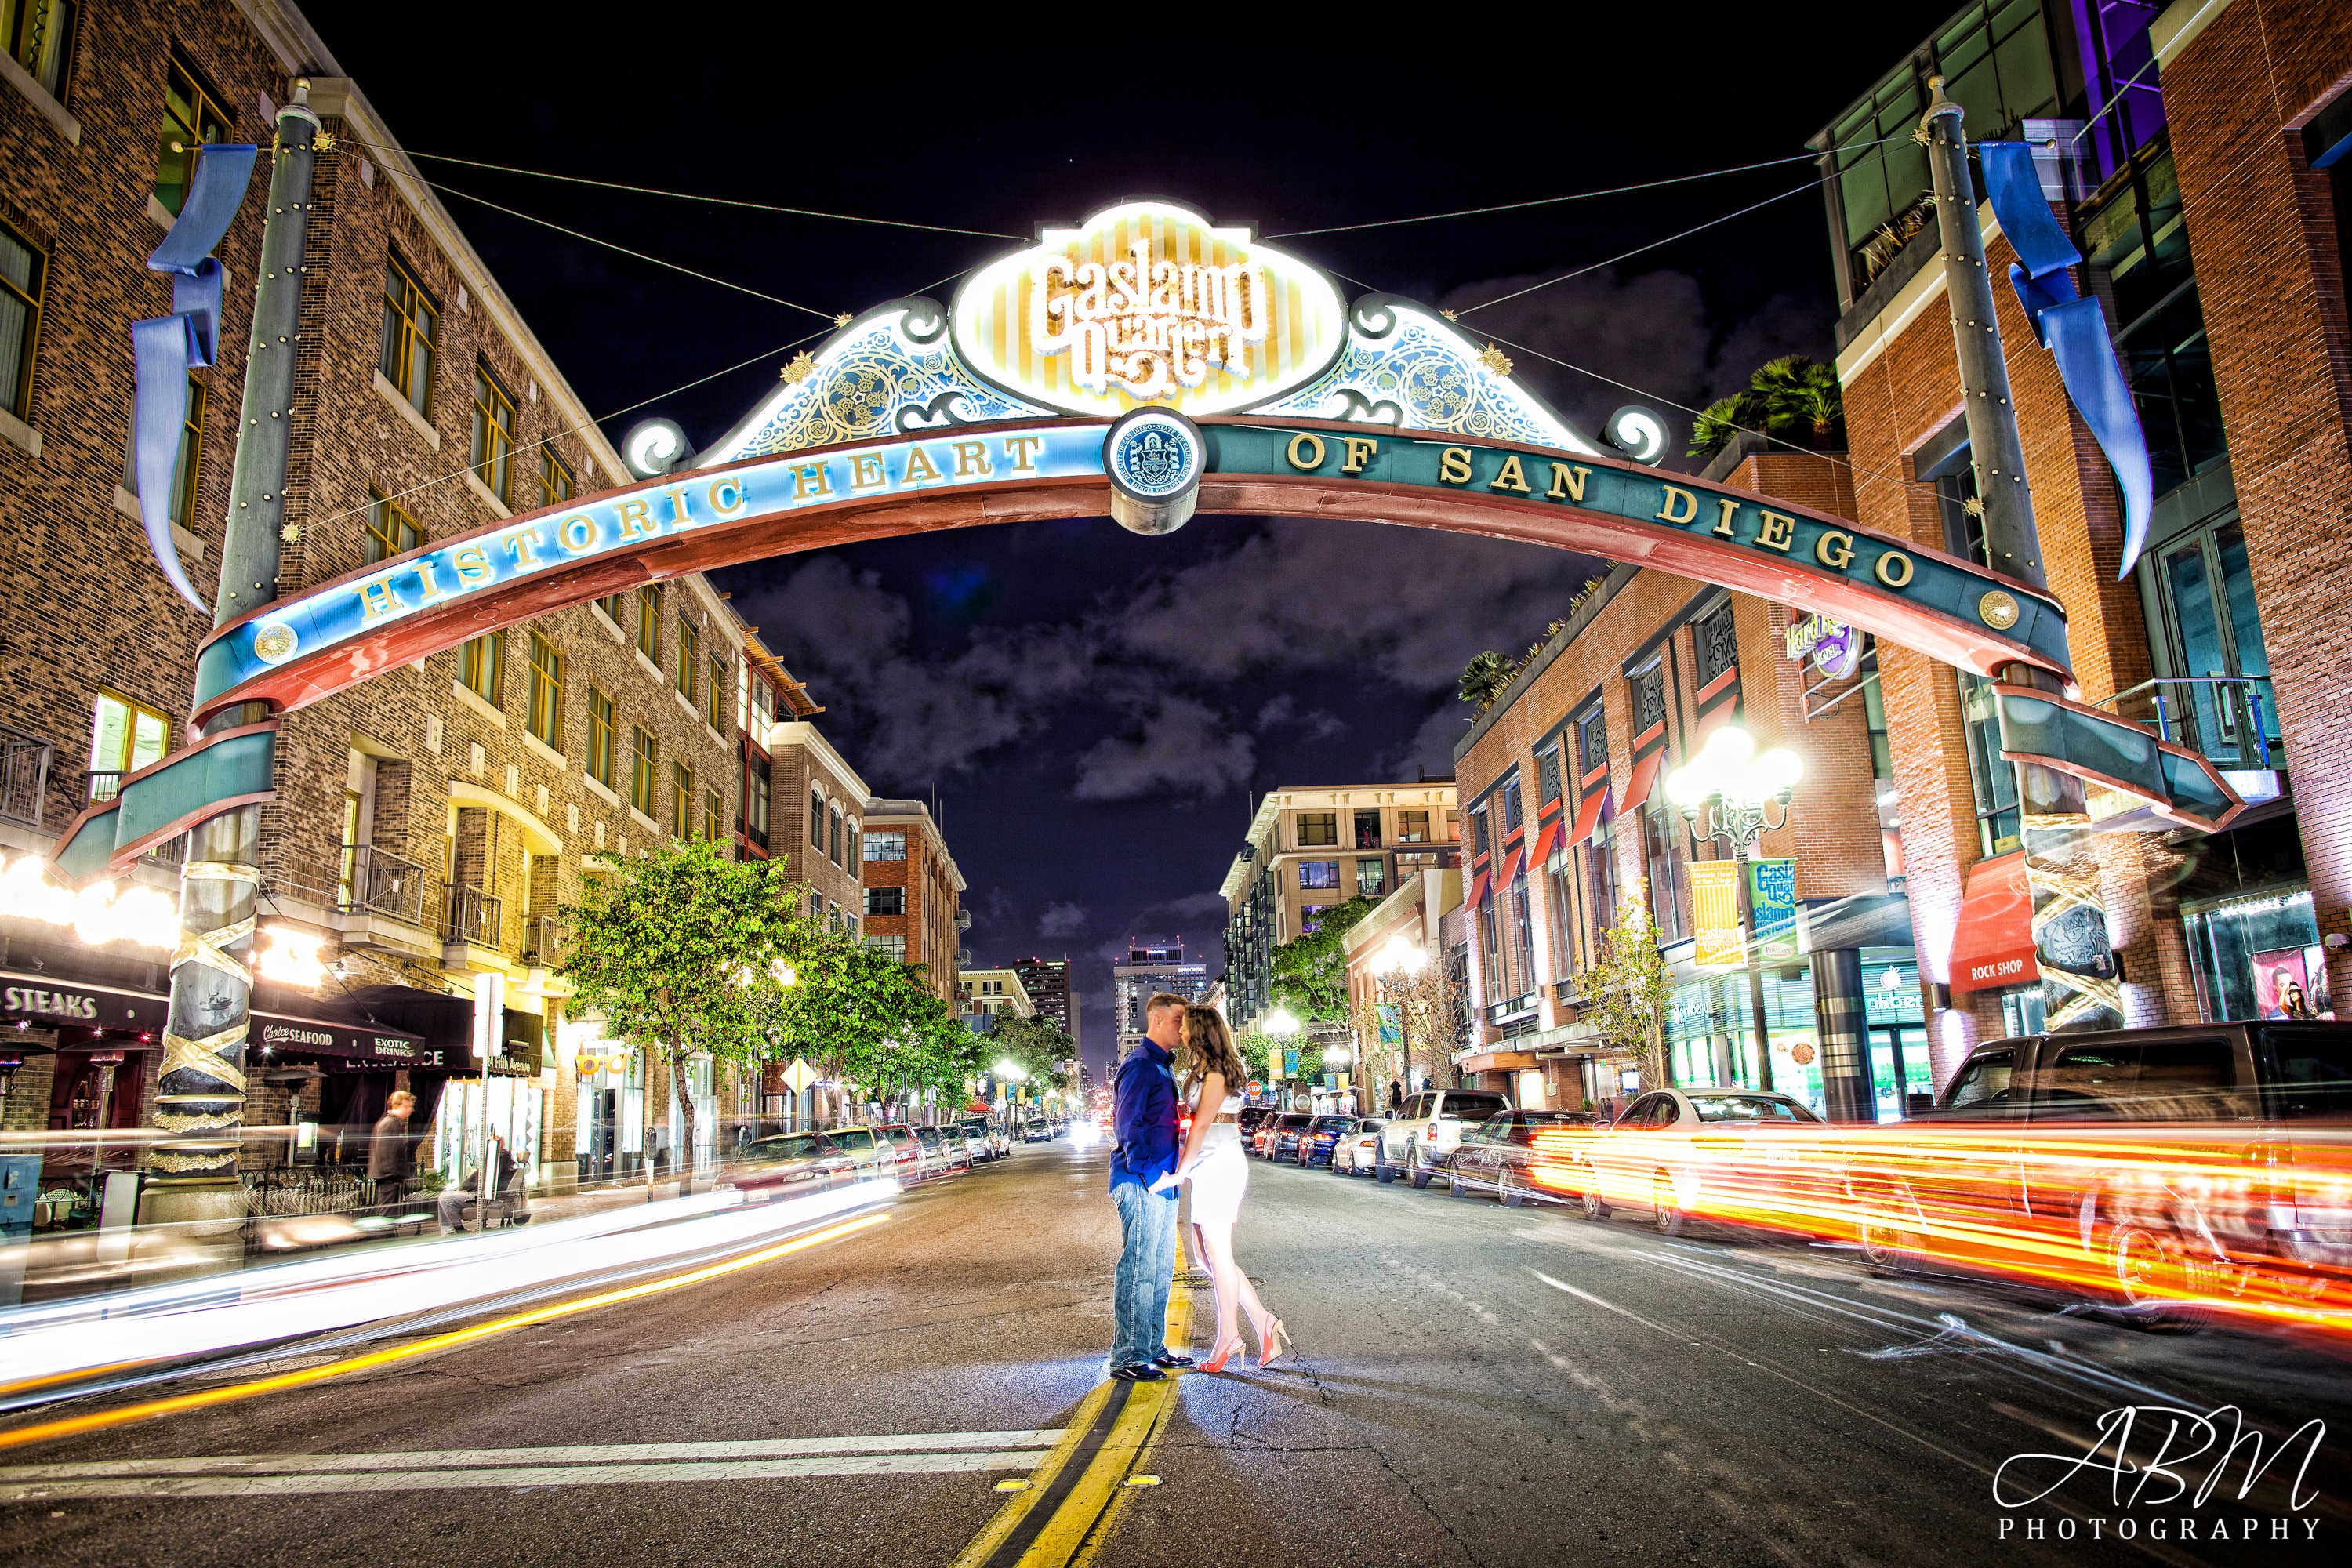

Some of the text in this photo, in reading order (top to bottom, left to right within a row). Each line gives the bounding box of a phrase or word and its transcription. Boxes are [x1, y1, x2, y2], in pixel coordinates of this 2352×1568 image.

[1029, 238, 1268, 355] Gaslamp
[1071, 314, 1250, 401] Quarter
[1133, 424, 1152, 435] DIEGO
[1156, 424, 1176, 435] STATE
[352, 434, 1915, 622] HISTORIC HEART OF SAN DIEGO
[1971, 959, 2023, 981] ROCK SHOP
[4, 986, 99, 1019] STEAKS
[263, 1025, 333, 1046] Choice SEAFOOD
[374, 1037, 410, 1050] EXOTIC
[375, 1045, 416, 1058] DRINKS
[509, 1057, 531, 1073] Avenue
